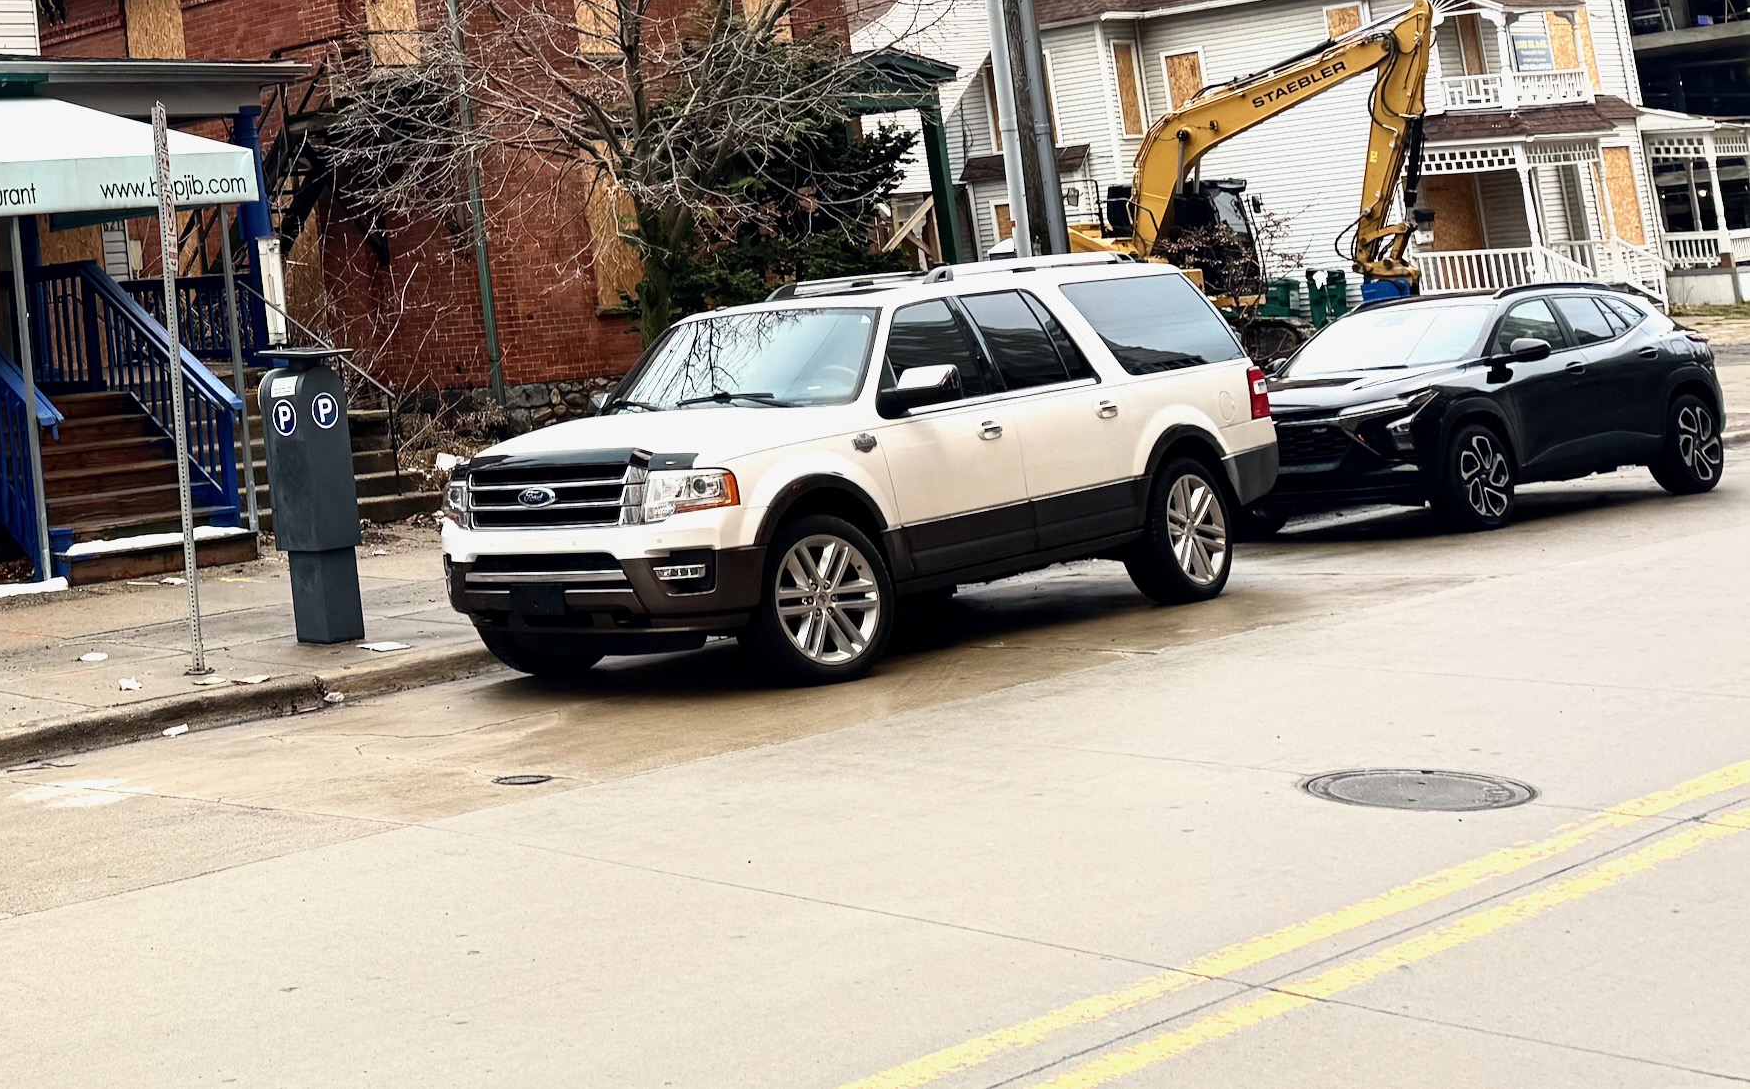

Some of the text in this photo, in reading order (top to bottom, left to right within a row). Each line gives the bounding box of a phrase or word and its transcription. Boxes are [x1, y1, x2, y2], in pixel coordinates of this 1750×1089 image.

[1252, 61, 1347, 108] STAEBLER
[99, 174, 247, 201] www.bpjib.com
[277, 405, 292, 430] P
[317, 398, 333, 423] P
